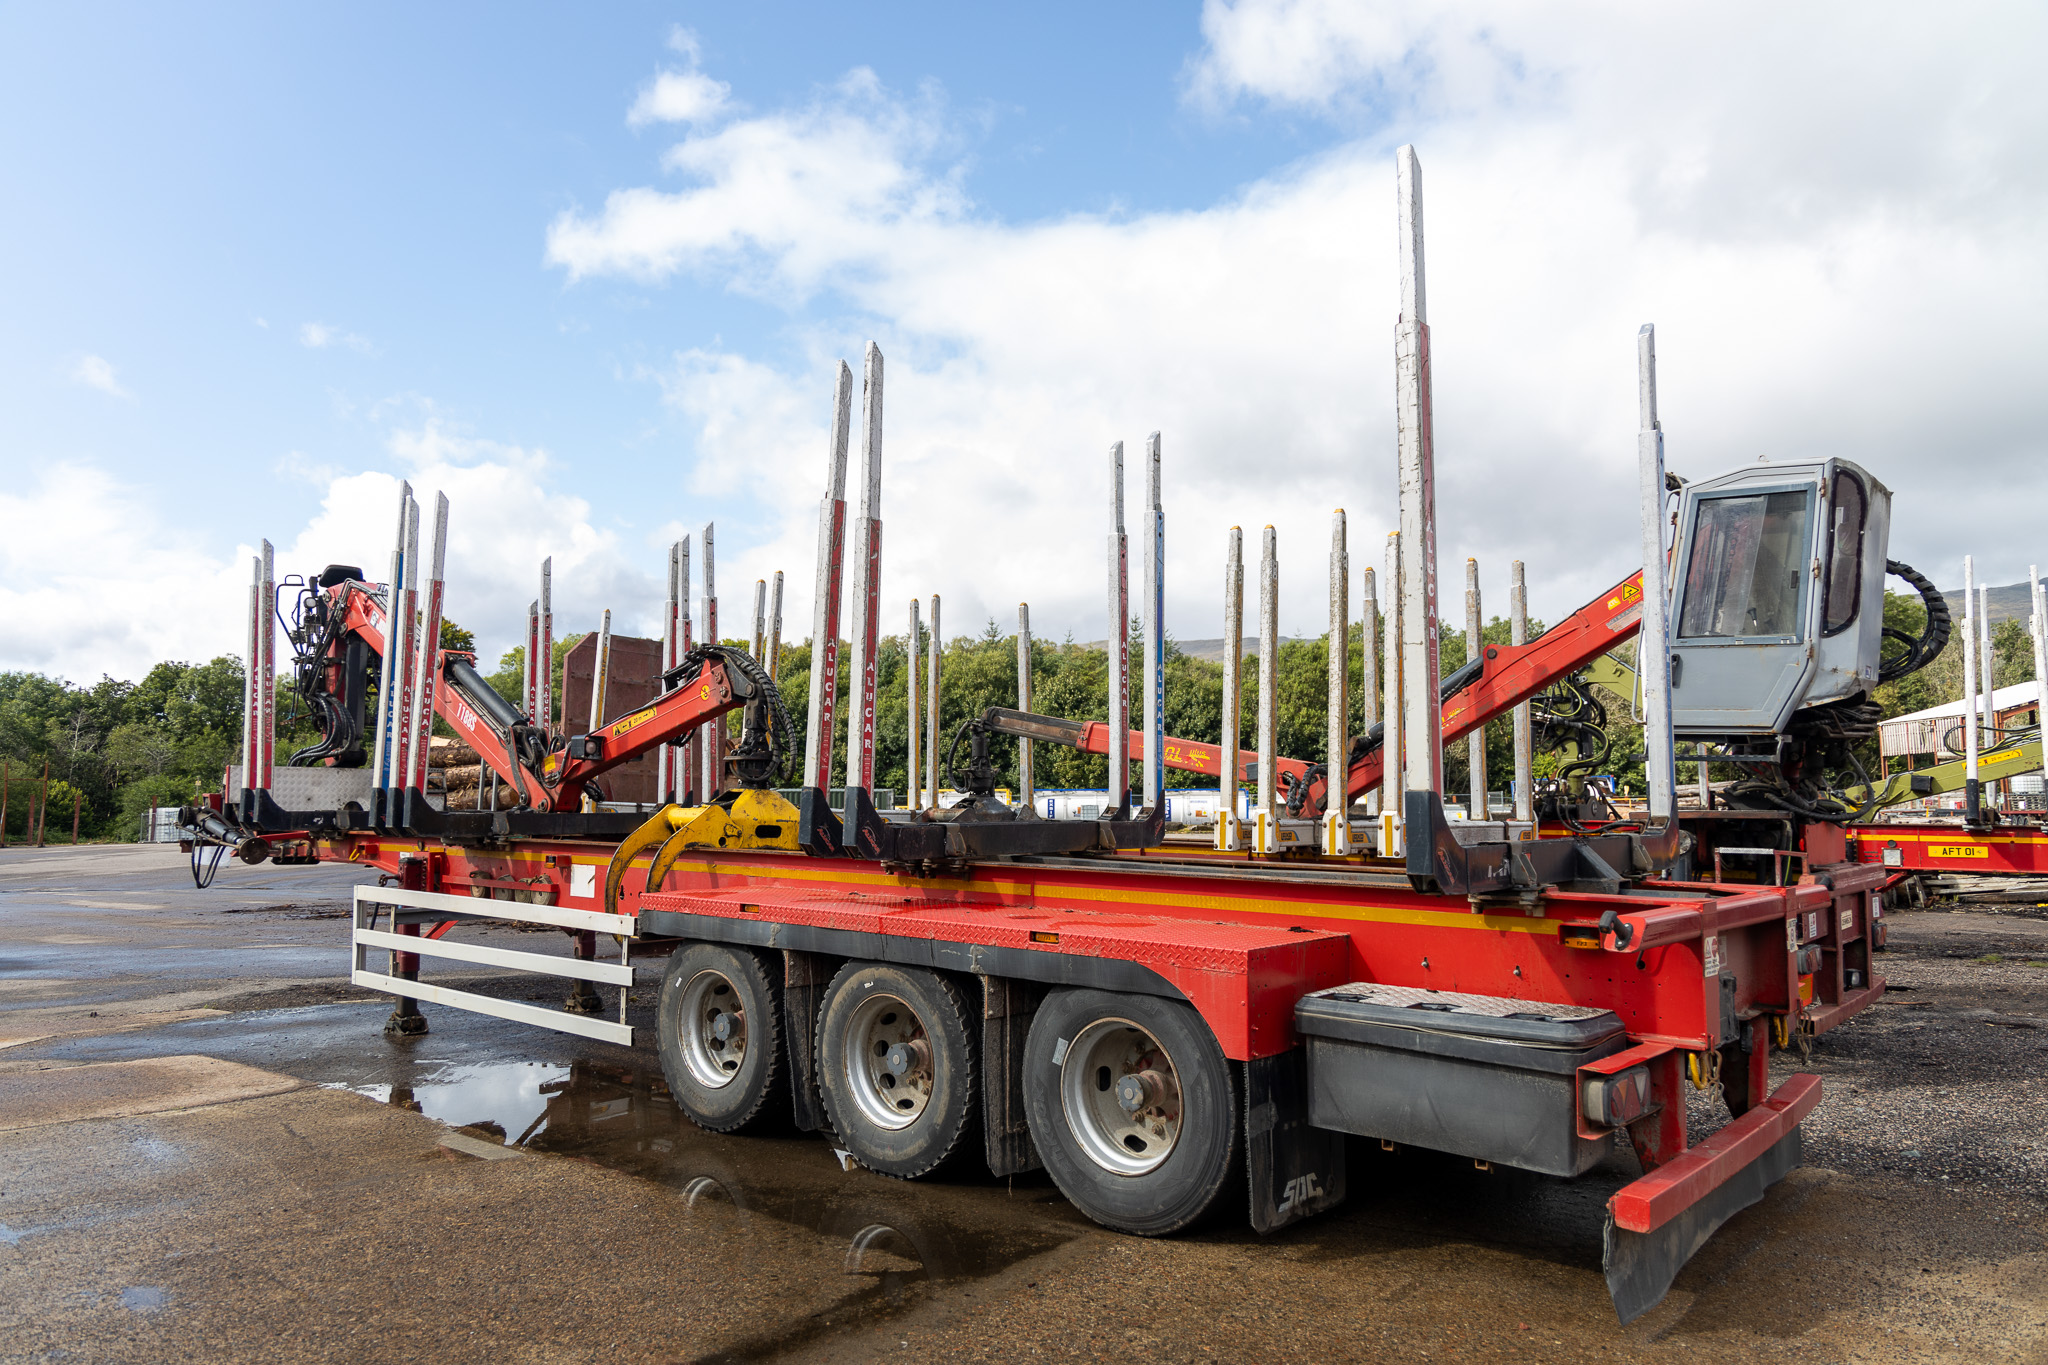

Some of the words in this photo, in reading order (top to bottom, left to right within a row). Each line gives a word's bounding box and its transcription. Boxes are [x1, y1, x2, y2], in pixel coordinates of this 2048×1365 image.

[1425, 520, 1437, 640] ALUCAR
[386, 680, 395, 738] ALUCAR
[420, 676, 434, 737] ALUCAR
[824, 636, 836, 722] ALUCAR
[864, 661, 876, 749] ALUCAR
[401, 685, 411, 745] ALUCAR
[456, 702, 478, 732] 1188S
[1942, 847, 1961, 856] AFT
